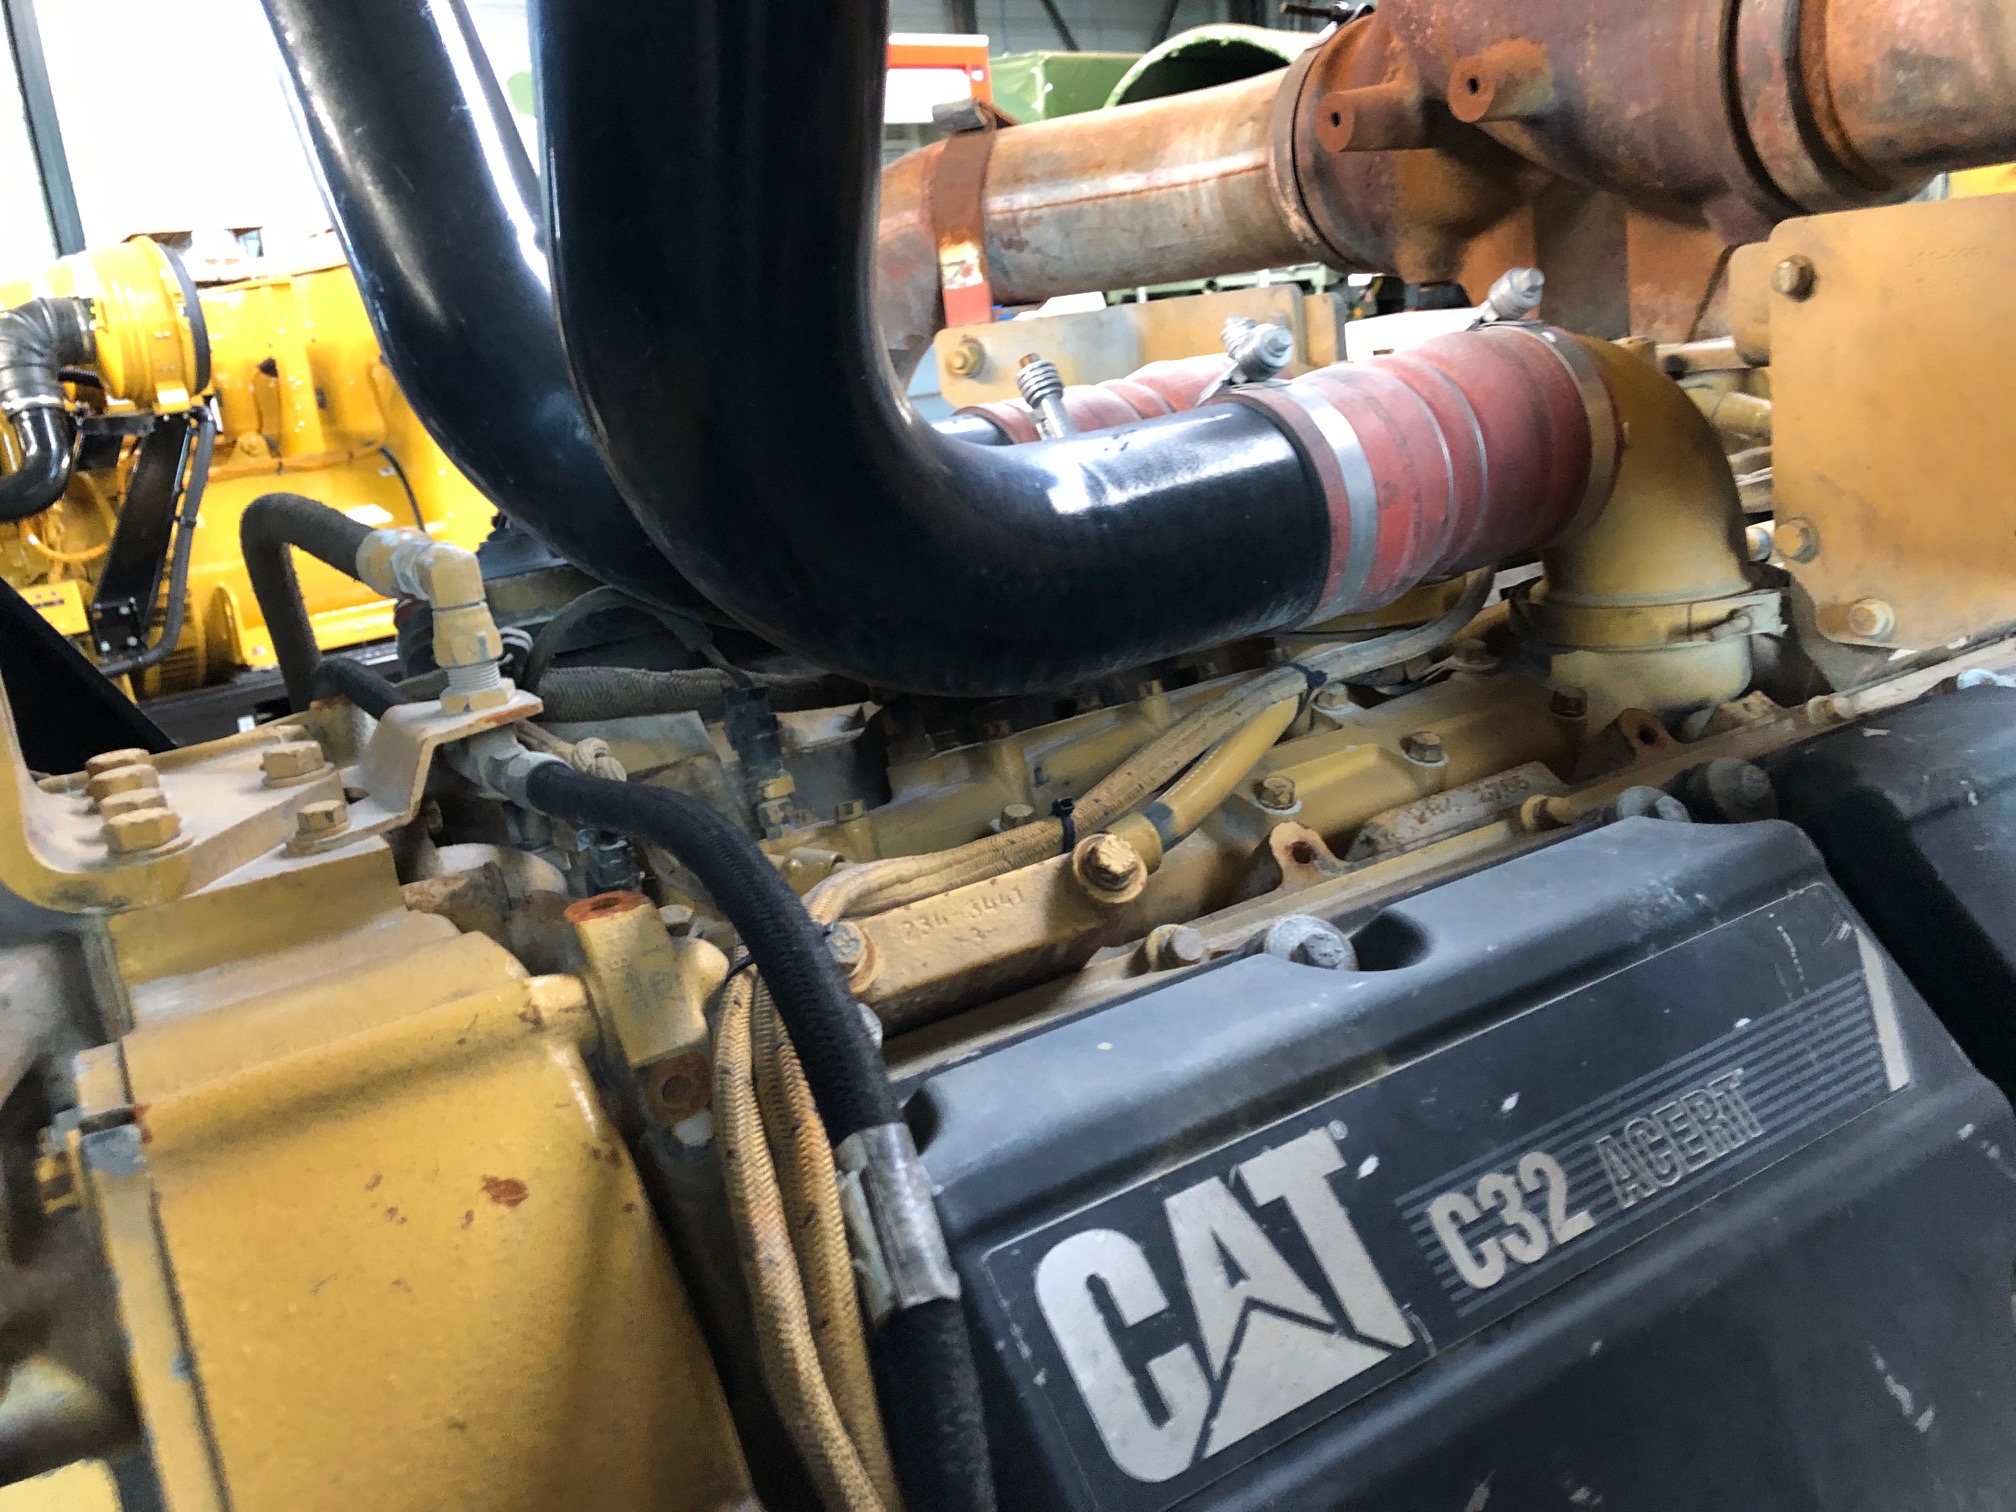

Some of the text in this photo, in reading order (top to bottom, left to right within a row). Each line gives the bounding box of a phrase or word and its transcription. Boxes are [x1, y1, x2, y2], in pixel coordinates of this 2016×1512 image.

[1034, 1126, 1416, 1483] CAT
[1428, 1068, 1764, 1290] C32 ACERT
